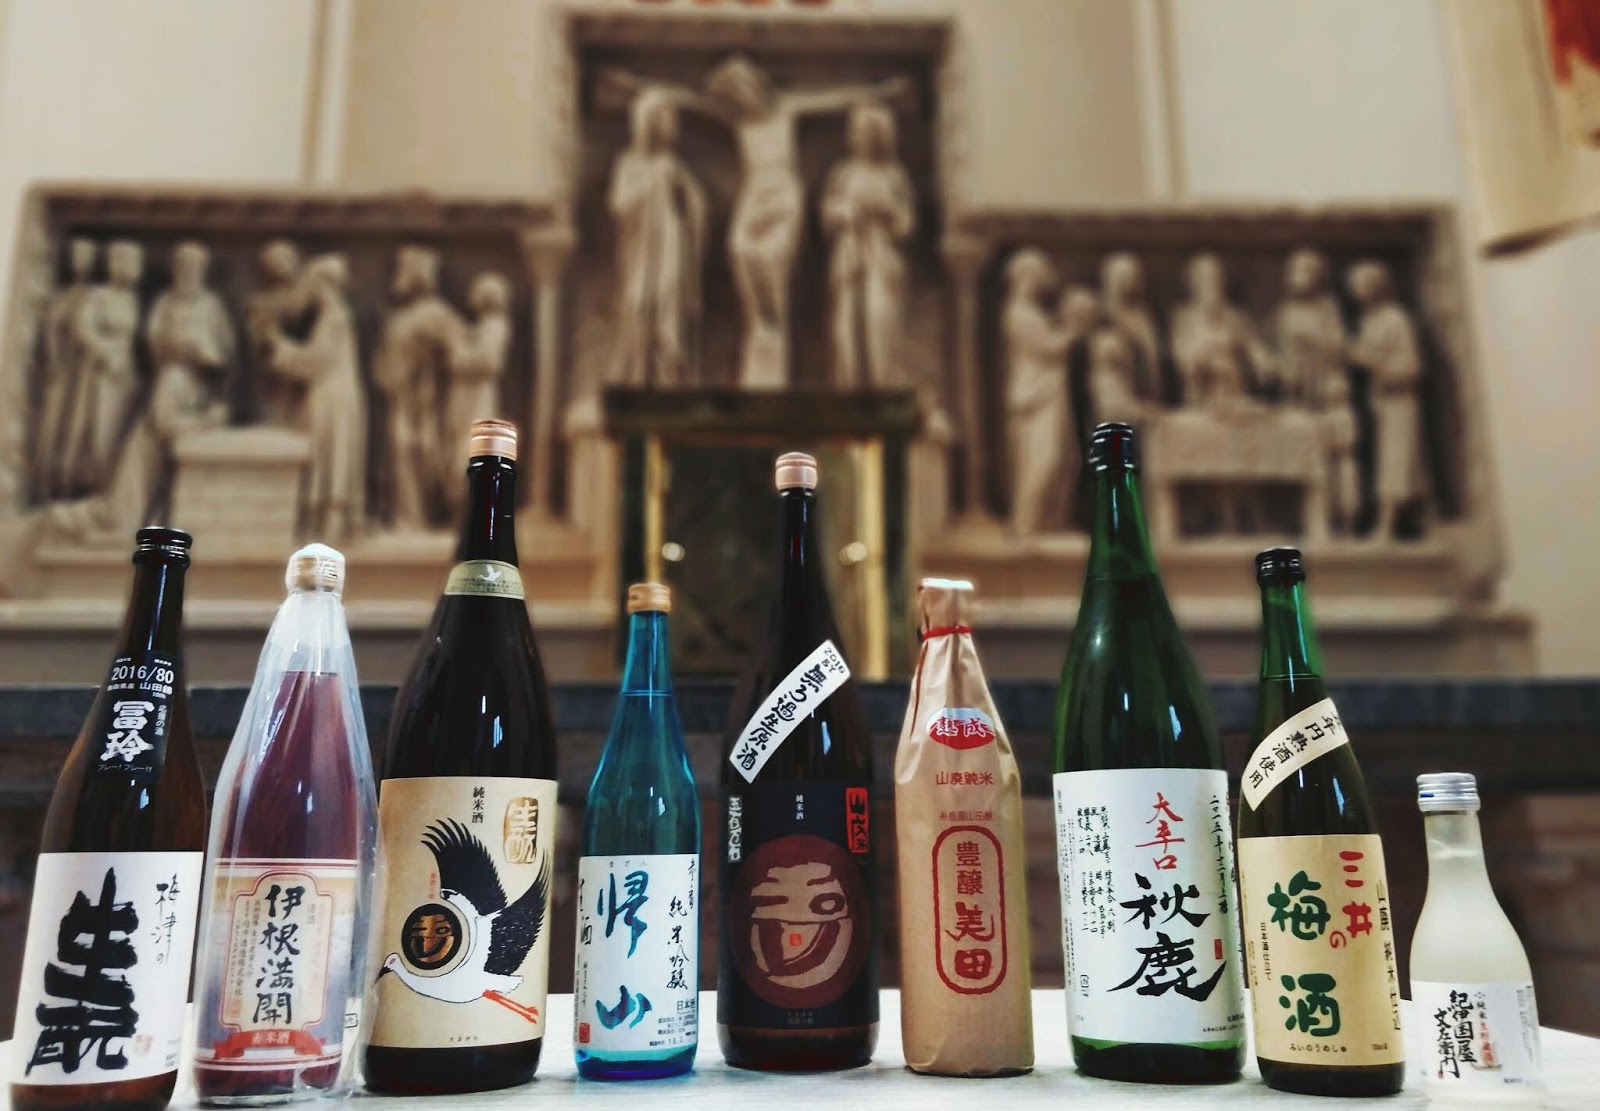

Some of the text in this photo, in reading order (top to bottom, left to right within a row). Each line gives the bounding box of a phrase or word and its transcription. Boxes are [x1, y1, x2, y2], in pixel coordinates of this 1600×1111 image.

[111, 665, 174, 684] 2016/80
[472, 786, 485, 824] 純米酒
[1135, 792, 1185, 870] 大辛口
[596, 870, 652, 1030] 帰山
[667, 896, 690, 990] 純米吟醸
[1106, 873, 1227, 1002] 秋鹿
[1267, 870, 1342, 1038] 梅酒
